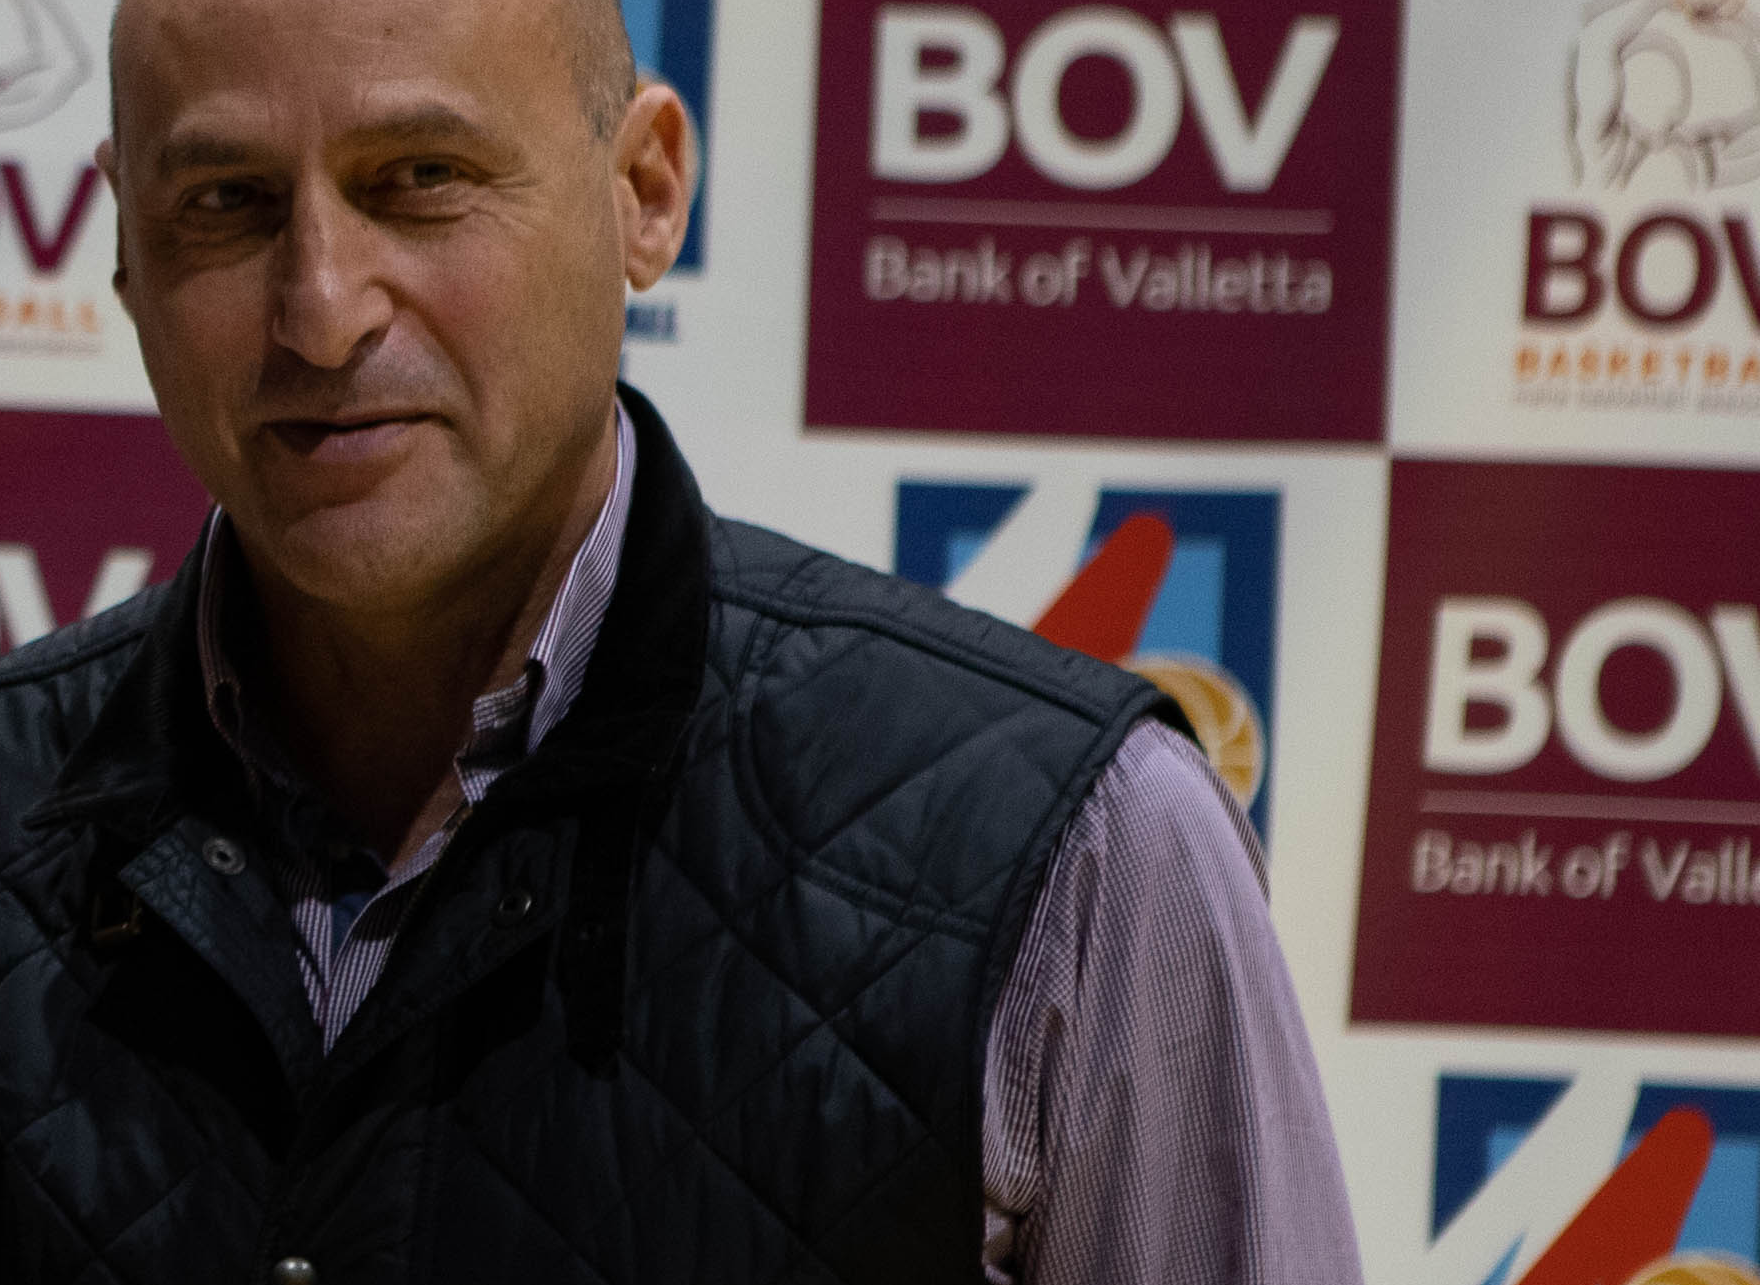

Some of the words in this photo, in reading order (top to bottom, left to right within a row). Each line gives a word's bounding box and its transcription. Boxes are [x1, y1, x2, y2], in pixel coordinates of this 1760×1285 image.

[866, 3, 1340, 193] BOV
[864, 235, 1011, 305] Bank
[1021, 243, 1090, 308] of
[1099, 245, 1333, 315] Valletta
[1423, 594, 1760, 784] BO
[1411, 828, 1554, 896] Bank
[1560, 829, 1631, 900] of
